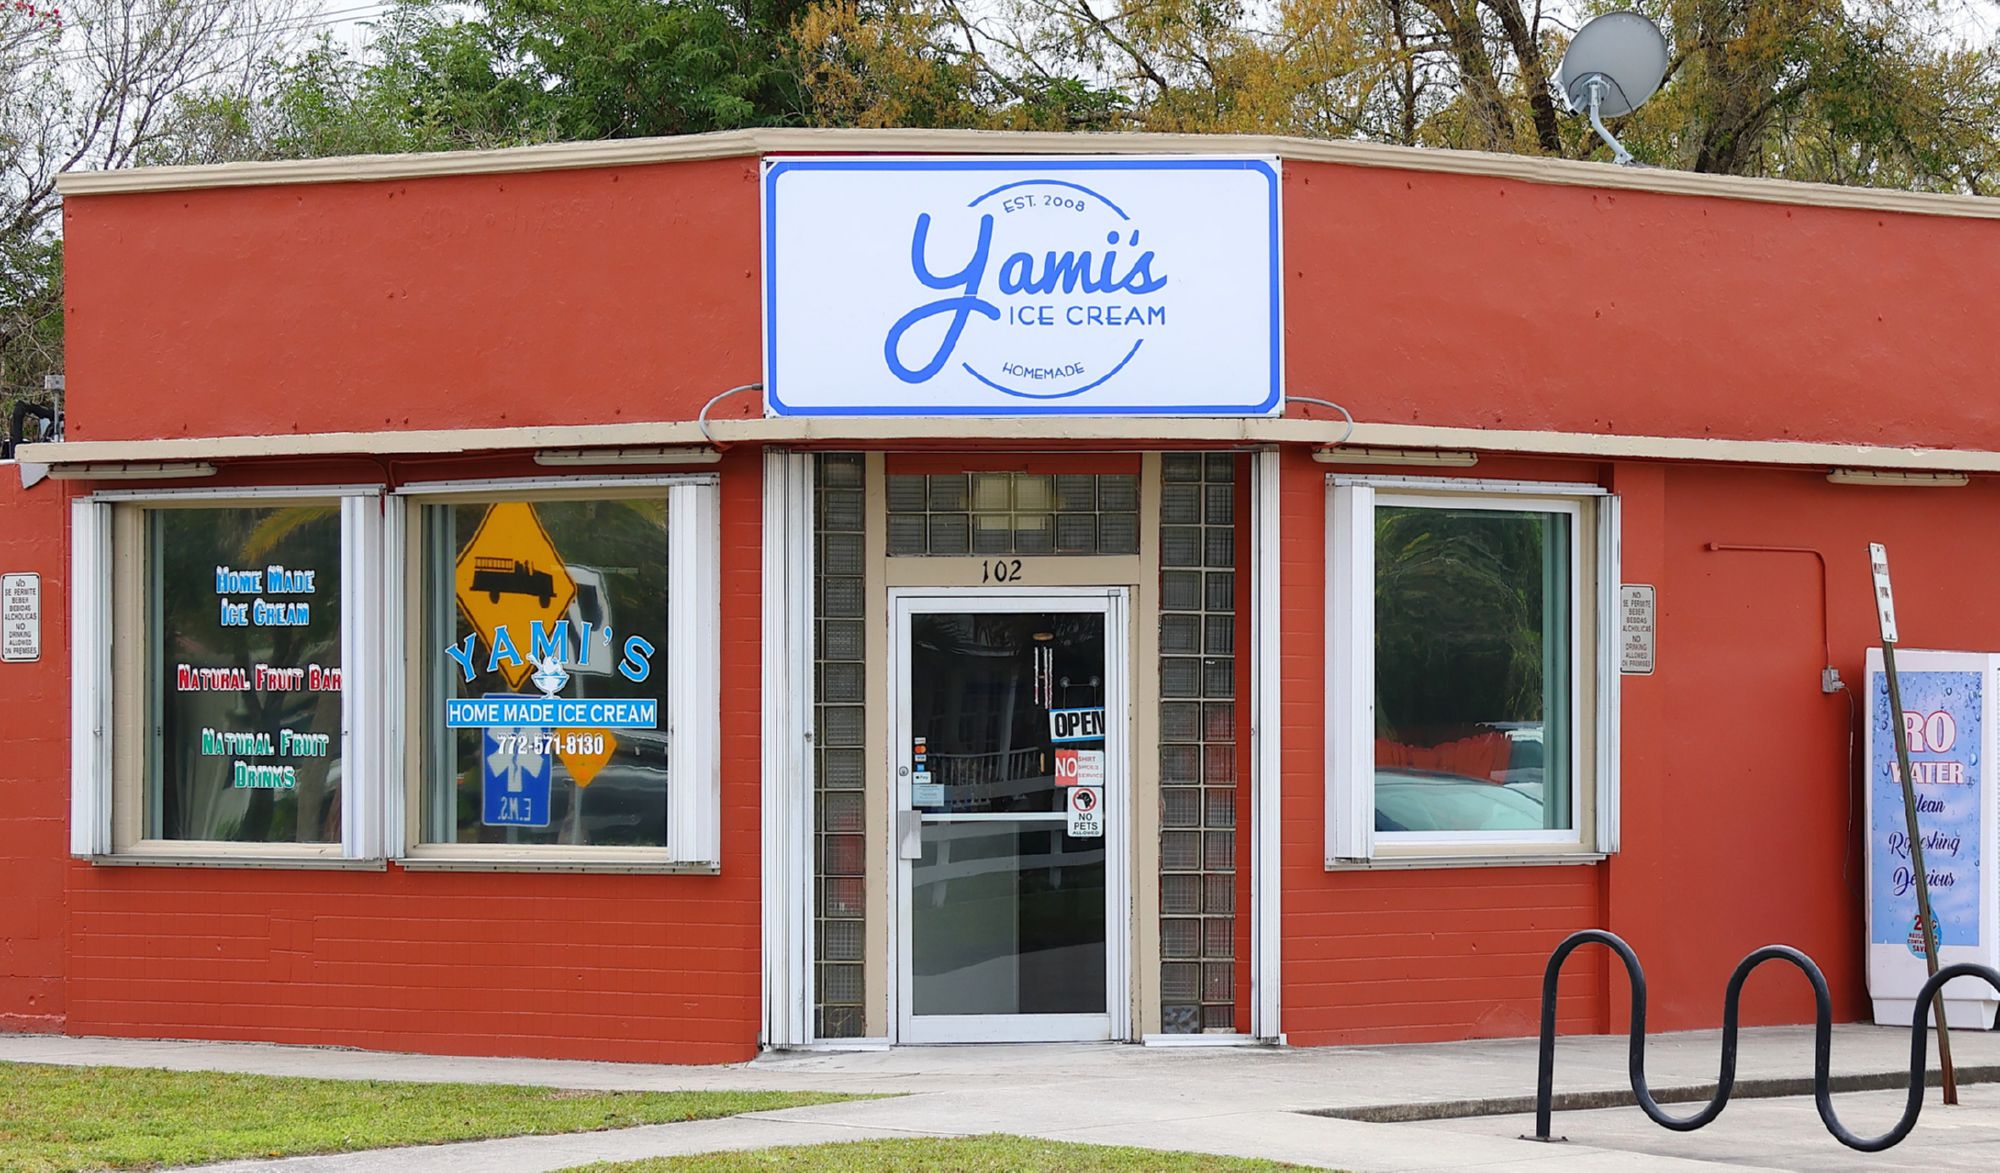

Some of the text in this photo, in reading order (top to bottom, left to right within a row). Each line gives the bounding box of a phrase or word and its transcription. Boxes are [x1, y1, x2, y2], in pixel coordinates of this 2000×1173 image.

[1003, 195, 1085, 213] EST. 2008
[884, 213, 1167, 384] Yami's
[1010, 306, 1165, 325] ICE CREAM
[1002, 362, 1085, 380] HOMEMADE
[216, 565, 315, 593] HOME MADE
[983, 560, 1022, 583] 102
[14, 588, 36, 596] PERMITE
[221, 598, 310, 626] ICE CREAM
[445, 620, 655, 683] YAMI'S
[177, 664, 250, 691] NATURAL
[255, 664, 304, 691] FRUIT
[449, 704, 654, 723] HOME MADE ICE CREAM
[1054, 710, 1104, 737] OPEN
[201, 728, 329, 756] NATURAL FRUIT
[1895, 710, 1957, 753] RO
[497, 732, 604, 755] 772-571-8130
[234, 761, 296, 789] DRINKS
[1055, 757, 1077, 778] NO
[1913, 793, 1945, 813] lean
[1074, 822, 1098, 831] PETS
[1079, 813, 1092, 821] NO
[1889, 831, 1960, 859] Reeshing
